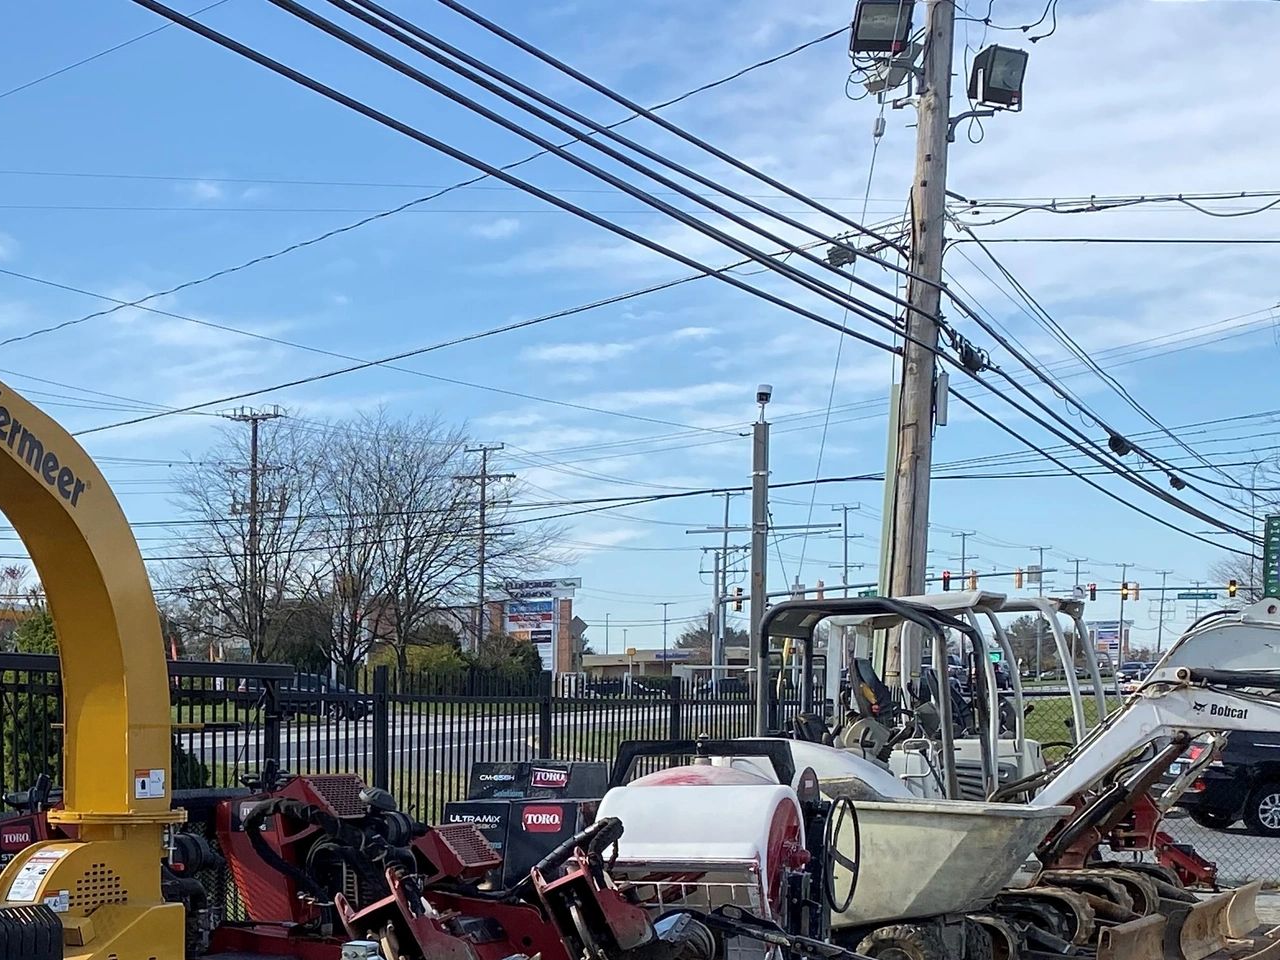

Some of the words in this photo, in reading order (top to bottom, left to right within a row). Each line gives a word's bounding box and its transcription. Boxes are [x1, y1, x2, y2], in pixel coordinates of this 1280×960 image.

[1210, 704, 1248, 719] Bobcat
[535, 772, 566, 781] TORO
[525, 814, 560, 825] TORO
[3, 832, 29, 844] TORO
